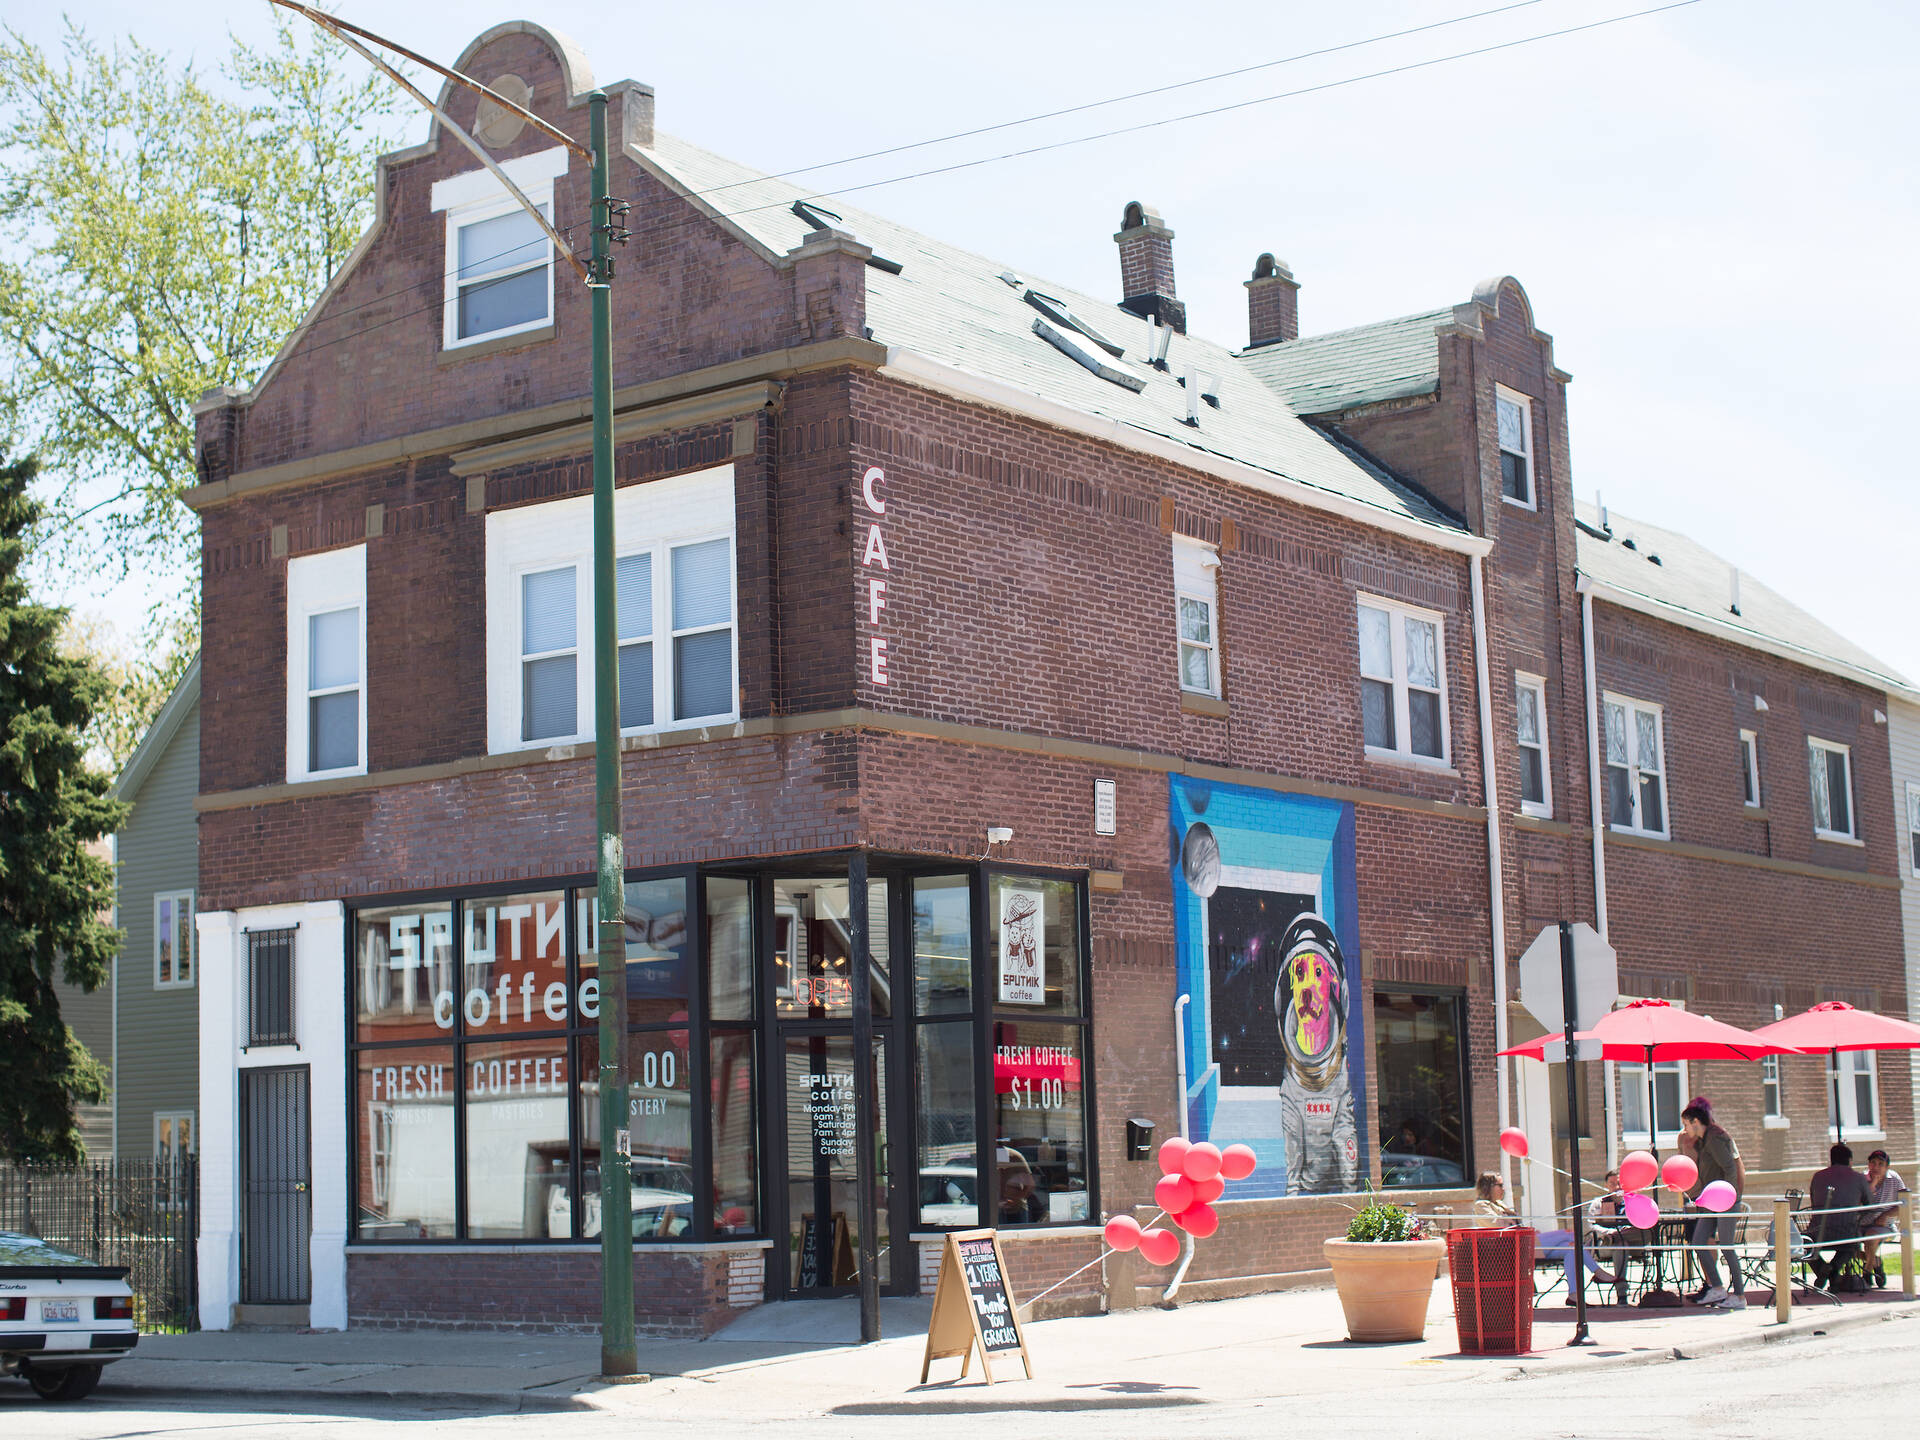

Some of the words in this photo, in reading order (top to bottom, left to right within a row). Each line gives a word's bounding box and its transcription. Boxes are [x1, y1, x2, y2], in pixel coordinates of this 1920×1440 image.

[862, 465, 890, 686] CAFE
[1003, 974, 1040, 988] SPUTNIK
[433, 971, 599, 1029] coffee
[1010, 989, 1033, 1000] coffee
[997, 1045, 1031, 1065] FRESH
[1035, 1045, 1073, 1066] COFFEE
[372, 1063, 443, 1101] FRESH
[473, 1057, 563, 1096] COFFEE
[634, 1051, 676, 1088] .00
[799, 1073, 855, 1088] SPUTN
[811, 1088, 856, 1101] coffe
[1011, 1076, 1063, 1111] $1.00
[383, 1108, 433, 1124] ESPRESSO
[491, 1102, 544, 1120] PASTRIES
[630, 1098, 667, 1116] STERY
[803, 1104, 856, 1114] Monday-Fri
[813, 1113, 834, 1121] 6am
[817, 1120, 856, 1130] Saturday
[813, 1129, 834, 1137] 7am
[820, 1138, 853, 1148] Sunday
[820, 1146, 854, 1155] Closed
[966, 1264, 982, 1288] 1
[976, 1262, 1002, 1283] YEAR
[972, 1292, 1009, 1315] Thank
[983, 1327, 1018, 1347] GRACIAS
